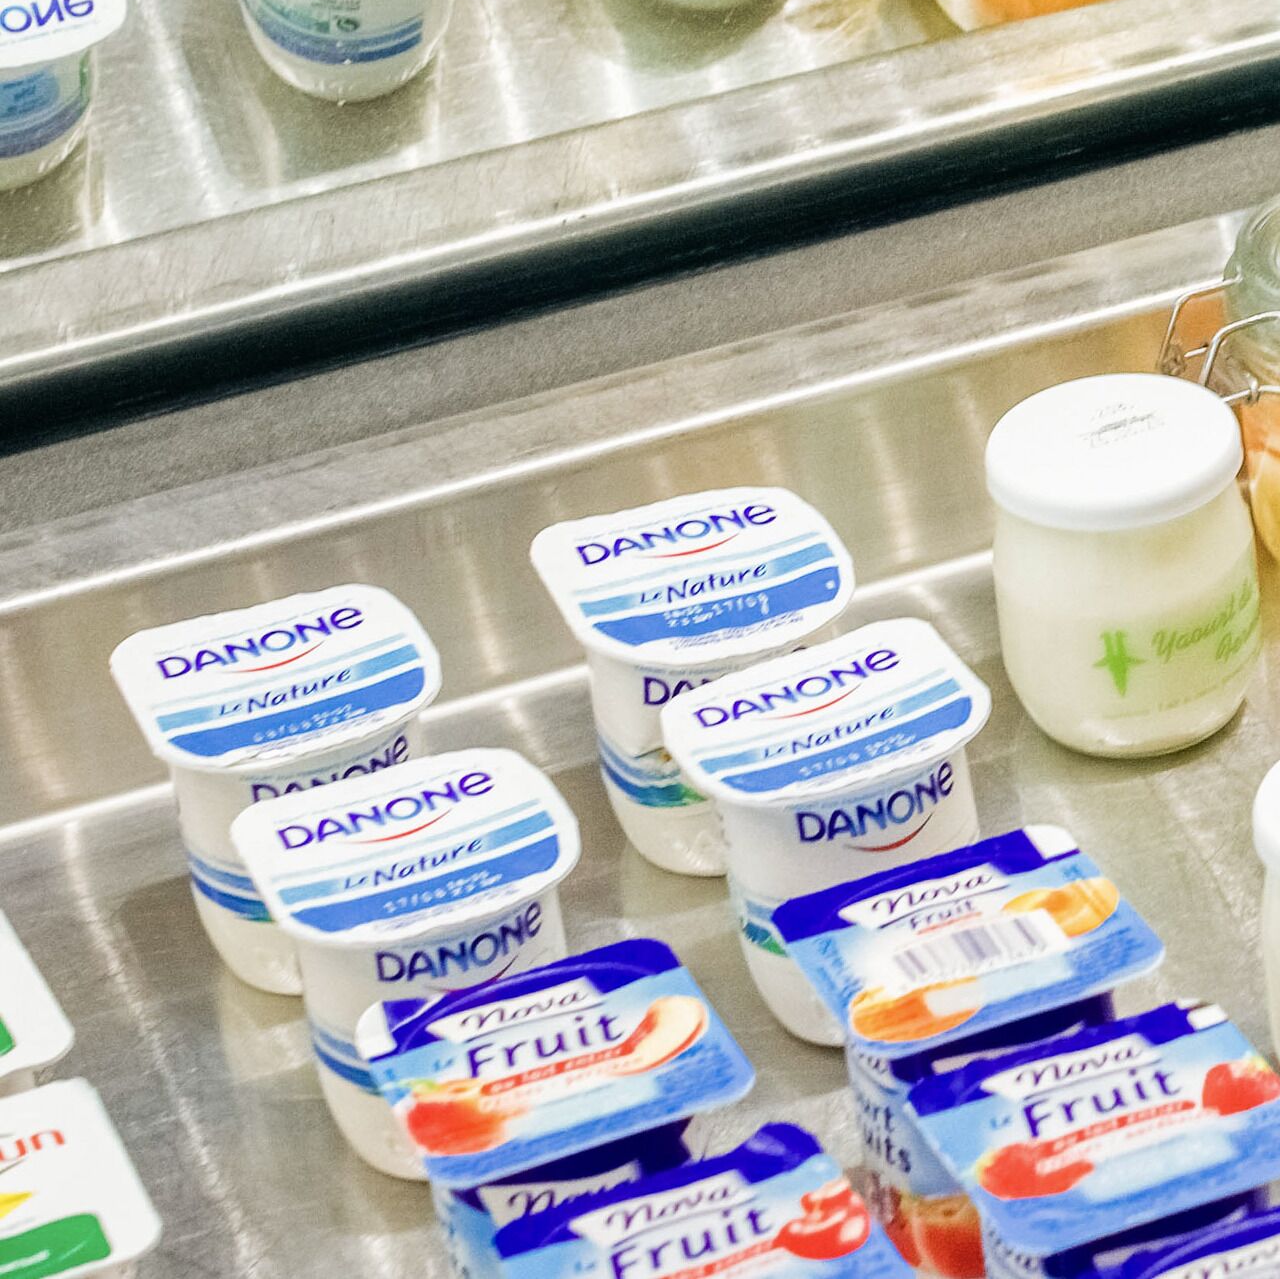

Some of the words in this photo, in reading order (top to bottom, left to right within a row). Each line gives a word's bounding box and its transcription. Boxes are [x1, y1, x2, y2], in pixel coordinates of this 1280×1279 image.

[576, 503, 778, 565] DANONE
[666, 563, 768, 604] Nature
[157, 606, 366, 680] DANONE
[247, 668, 351, 714] Nature
[693, 648, 901, 728] DANONE
[792, 704, 895, 754] Nature
[277, 771, 496, 849] DANONE
[796, 761, 954, 843] DANONE
[373, 837, 482, 887] Nature
[872, 872, 993, 915] Nova
[909, 900, 977, 930] Fruit
[375, 901, 543, 983] DANONE
[460, 989, 589, 1029] Nova
[467, 1013, 626, 1078] Fruit
[1014, 1040, 1143, 1087] Nova
[1022, 1066, 1184, 1139] Fruit
[605, 1183, 733, 1231] Nova
[610, 1209, 776, 1279] Fruit
